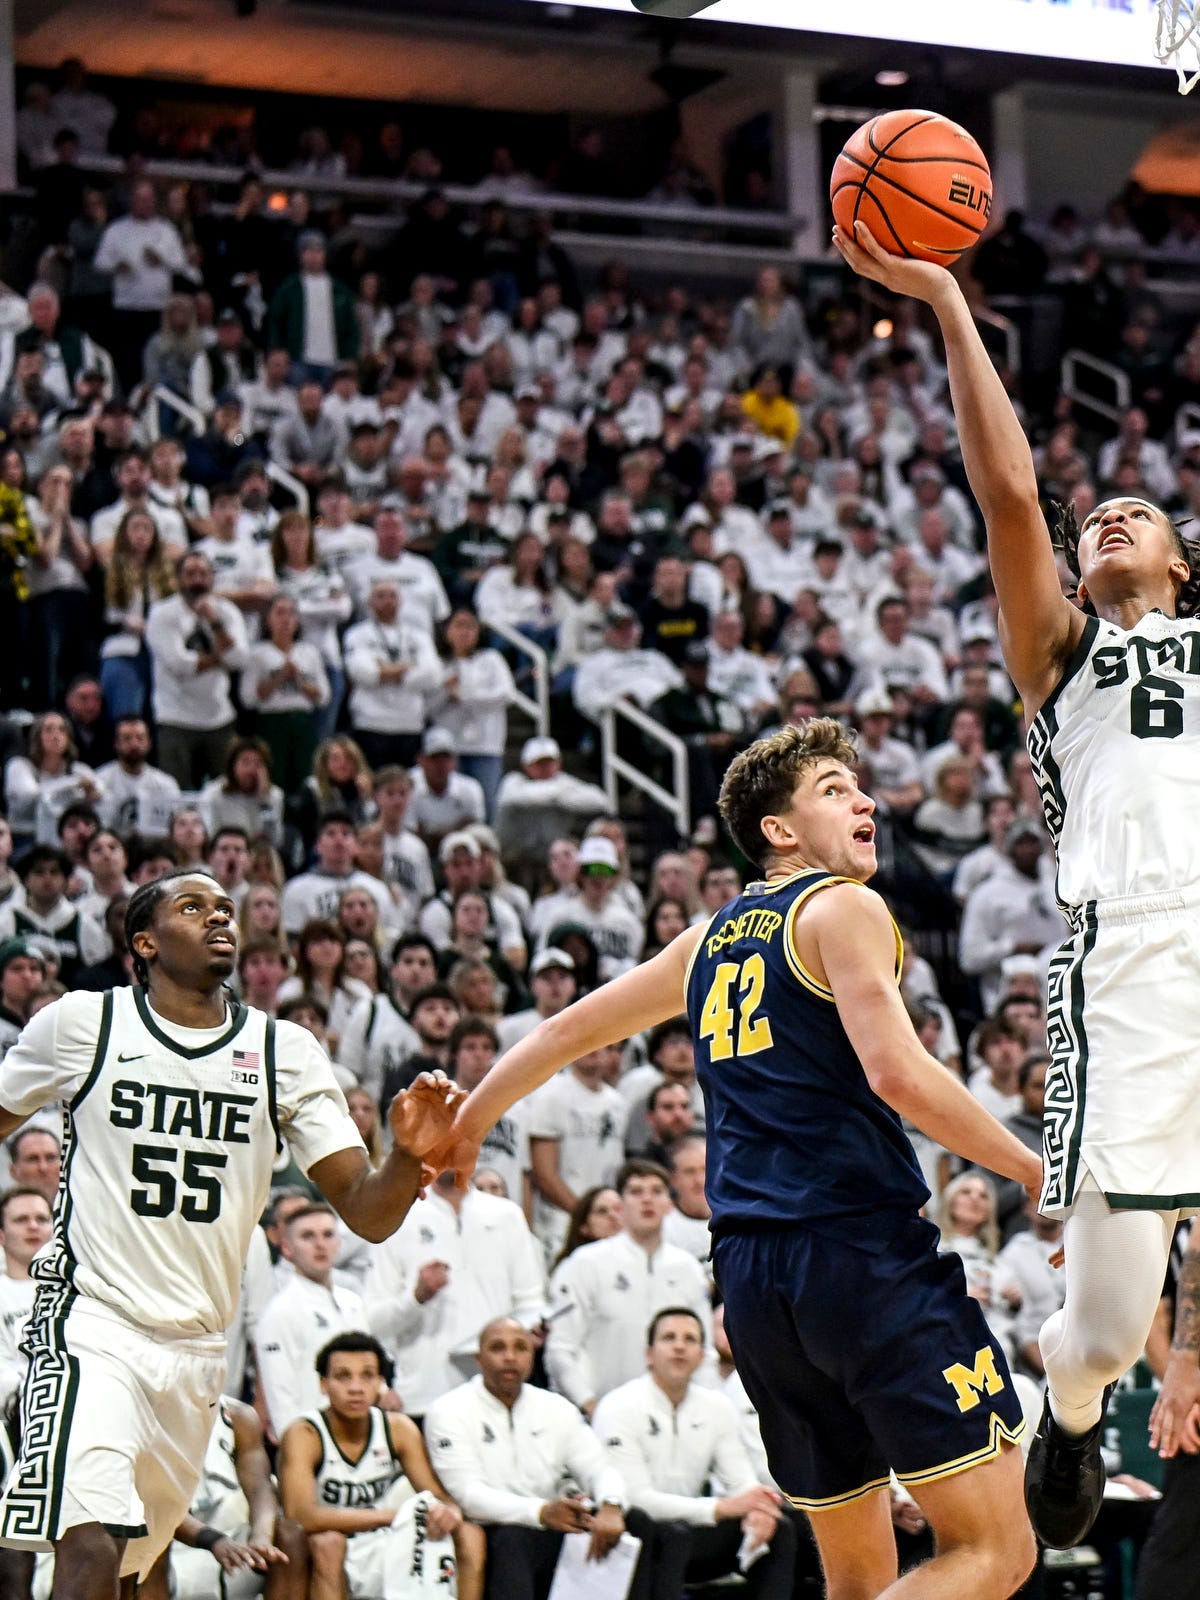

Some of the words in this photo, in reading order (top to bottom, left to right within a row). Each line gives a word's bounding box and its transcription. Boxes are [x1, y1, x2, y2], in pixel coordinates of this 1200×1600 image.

[1130, 674, 1185, 740] 6
[700, 952, 774, 1064] 42
[109, 1079, 259, 1144] STATE
[130, 1143, 229, 1224] 55
[941, 1345, 1005, 1413] M
